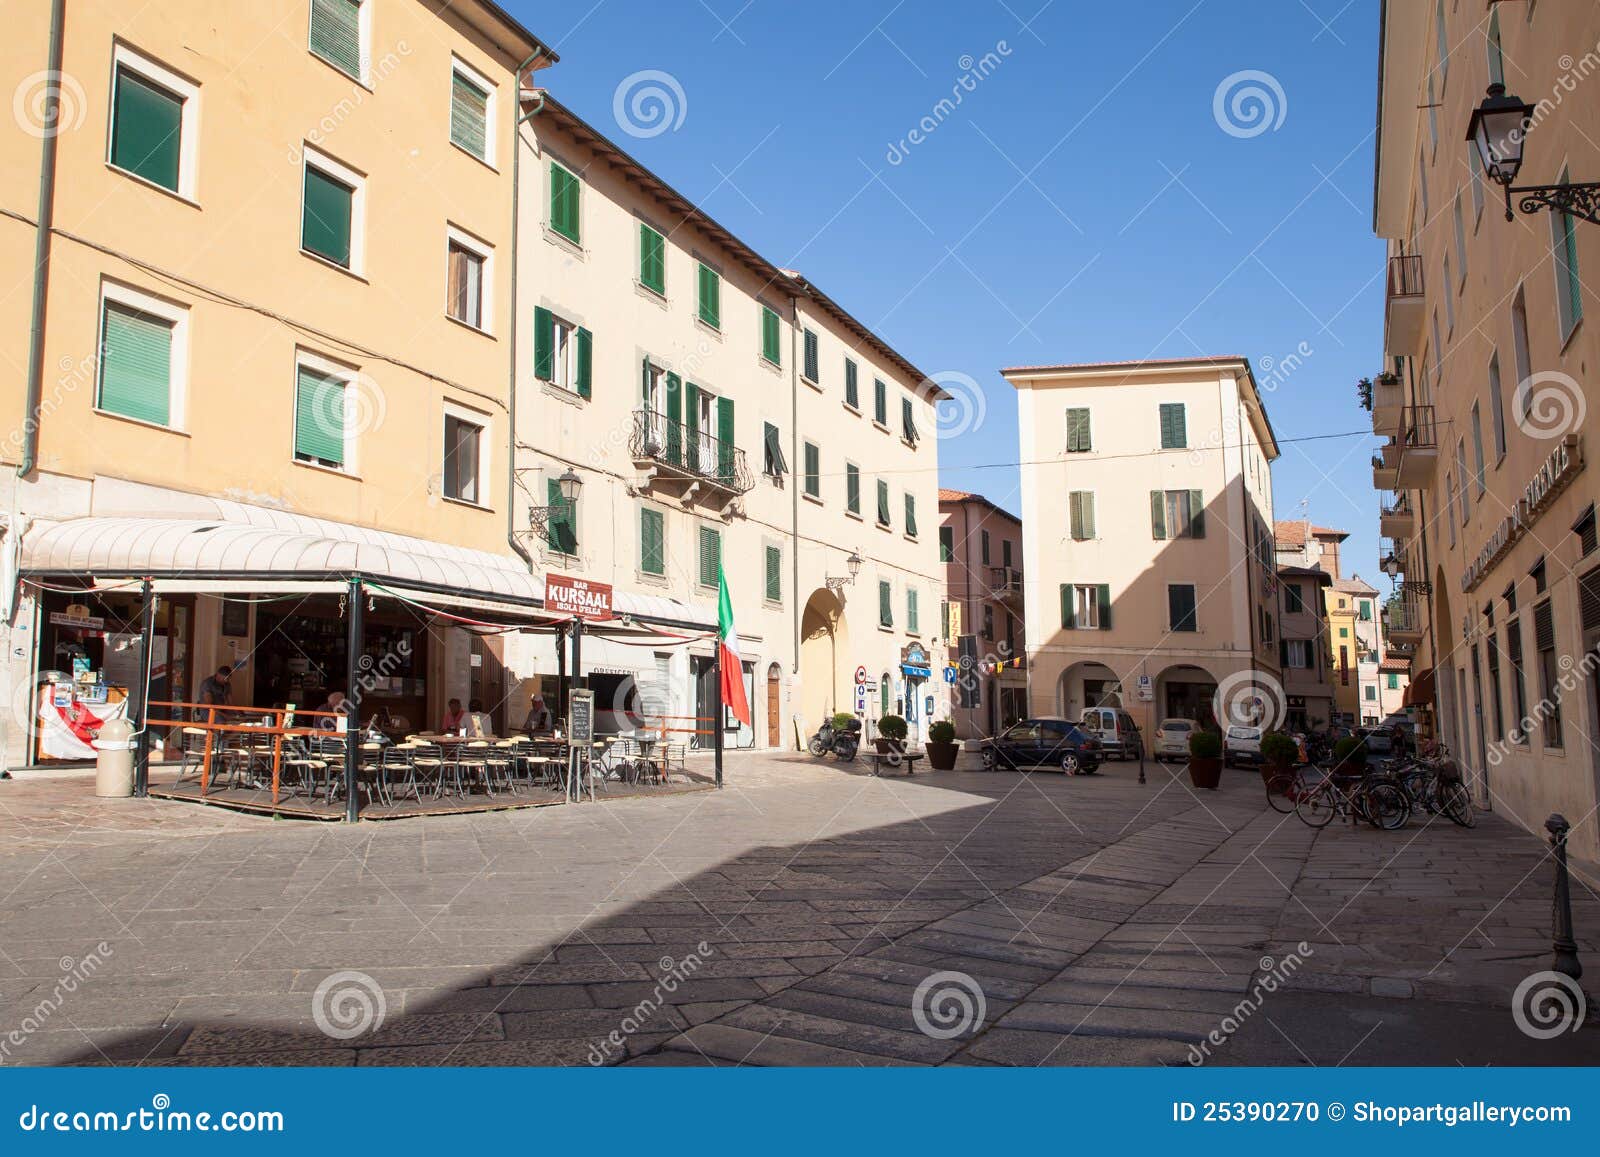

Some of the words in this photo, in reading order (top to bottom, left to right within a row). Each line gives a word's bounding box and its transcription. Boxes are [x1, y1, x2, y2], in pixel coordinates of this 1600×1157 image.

[573, 581, 588, 590] BAR
[549, 585, 609, 608] KURSAAL
[557, 602, 577, 612] ISOLA
